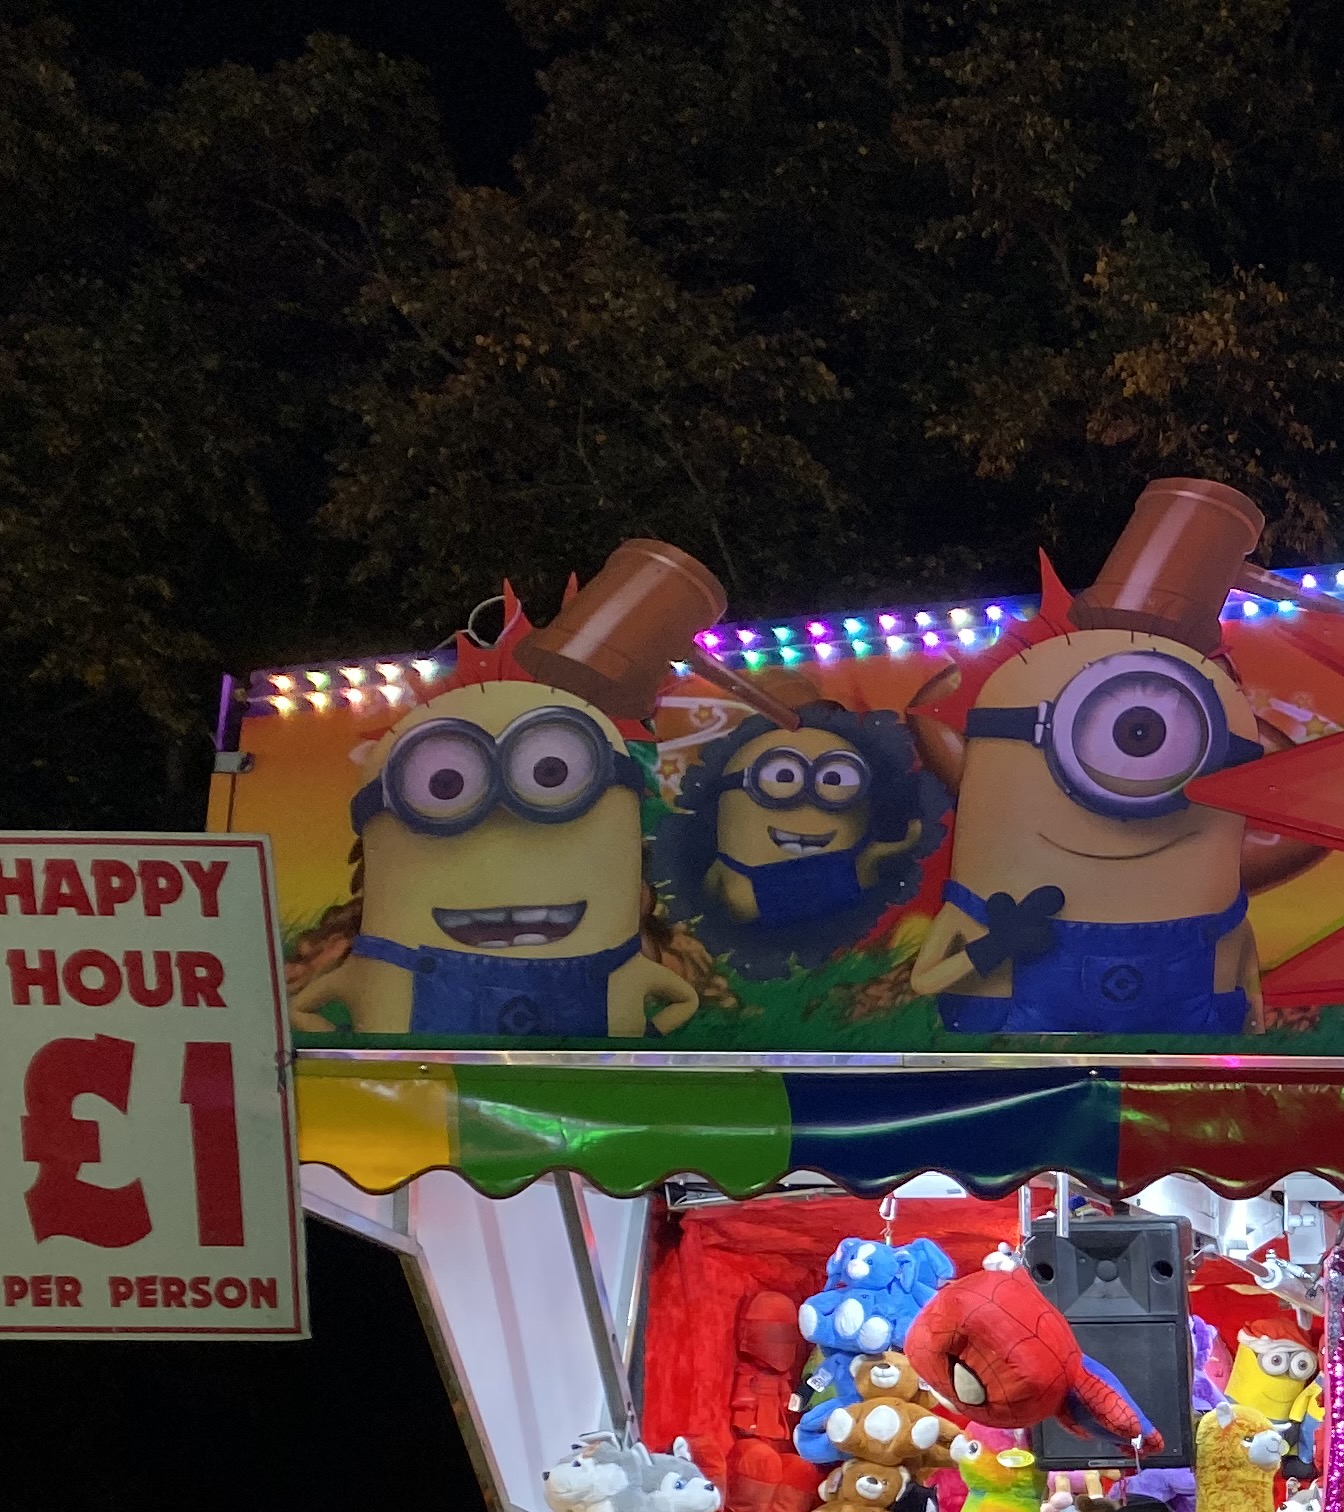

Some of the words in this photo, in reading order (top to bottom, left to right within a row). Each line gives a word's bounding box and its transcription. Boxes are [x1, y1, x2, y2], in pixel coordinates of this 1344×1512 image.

[0, 858, 229, 918] HAPPY
[6, 949, 227, 1008] HOUR
[20, 1033, 245, 1249] £1
[3, 1275, 83, 1308] PER
[108, 1275, 279, 1309] PERSON
